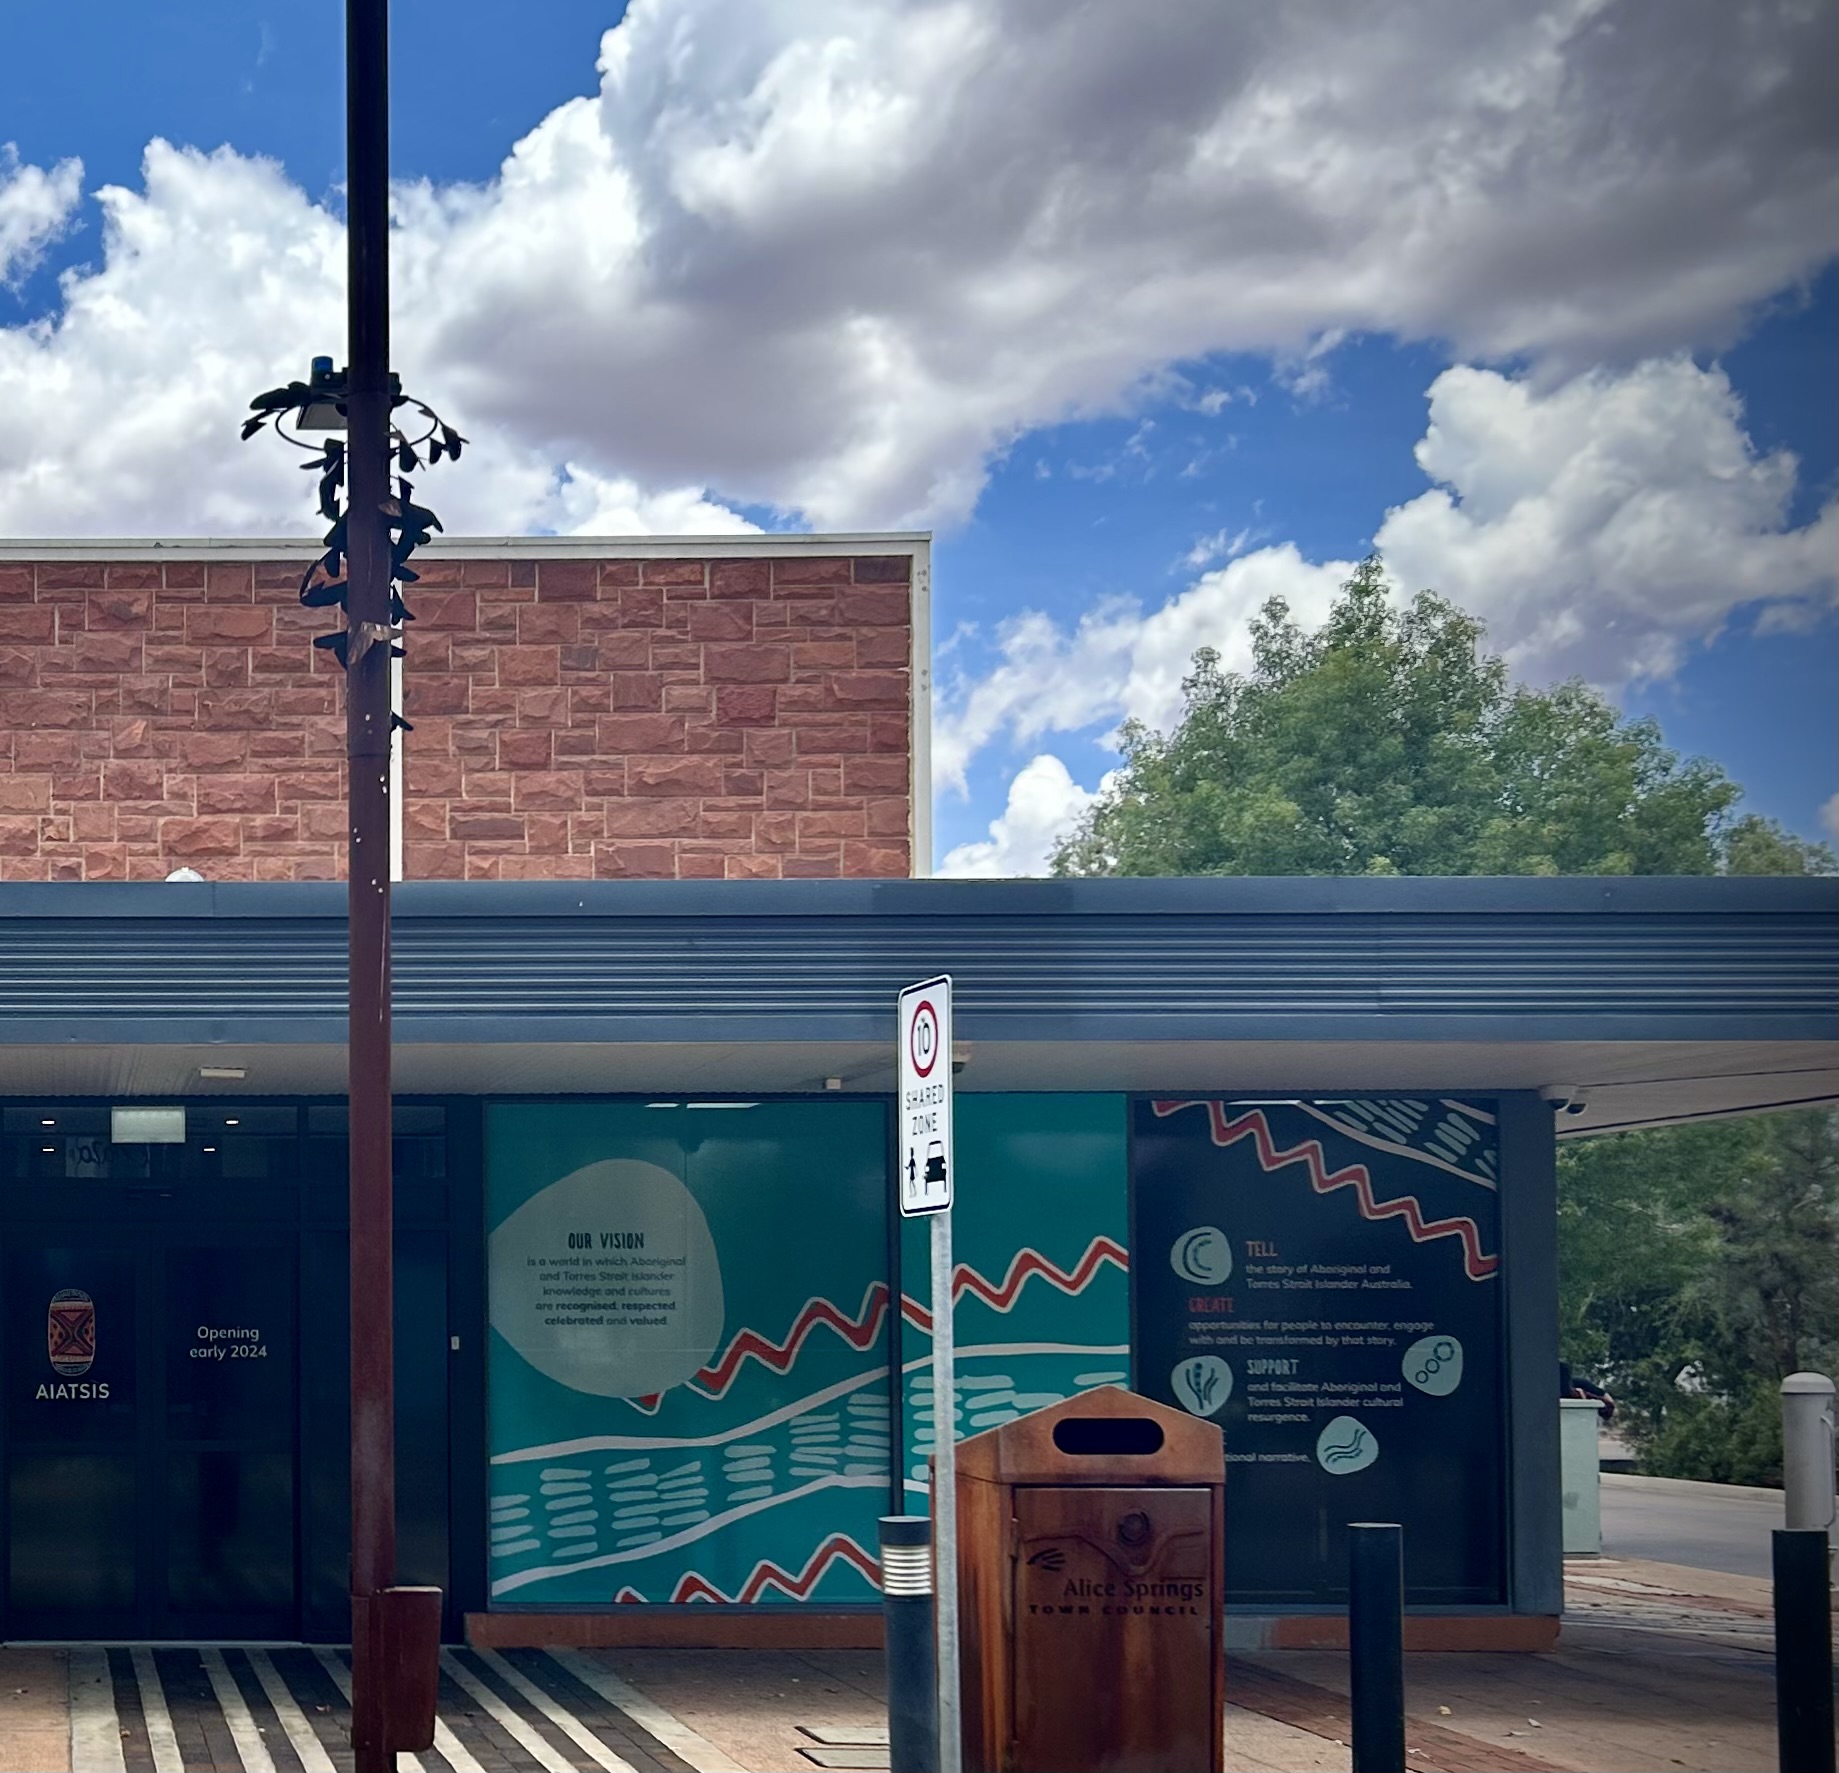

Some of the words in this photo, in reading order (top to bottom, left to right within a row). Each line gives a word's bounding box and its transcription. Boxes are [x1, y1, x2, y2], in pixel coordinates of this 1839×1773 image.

[918, 1023, 930, 1056] 10
[906, 1085, 944, 1110] SHARED
[912, 1113, 937, 1135] ZONE
[568, 1233, 592, 1249] OUR
[600, 1233, 644, 1249] VISION
[1245, 1241, 1278, 1257] TELL
[527, 1257, 535, 1266] is
[549, 1257, 579, 1266] world
[582, 1257, 592, 1266] in
[596, 1257, 627, 1266] which
[630, 1257, 686, 1268] Aboriginal
[1246, 1264, 1264, 1274] the
[1266, 1265, 1293, 1276] story
[1296, 1264, 1309, 1274] of
[1310, 1264, 1367, 1276] Aboriginal
[1368, 1264, 1391, 1274] and
[540, 1272, 559, 1281] and
[563, 1272, 596, 1281] Torres
[599, 1272, 629, 1281] Strait
[632, 1272, 673, 1281] Islander
[1246, 1279, 1280, 1289] Torres
[1282, 1279, 1313, 1289] Strait
[1315, 1279, 1359, 1289] Islander
[1361, 1279, 1413, 1289] Australia.
[543, 1287, 602, 1297] knowledge
[604, 1287, 625, 1296] and
[628, 1287, 670, 1296] cultures
[1188, 1297, 1233, 1313] CREATE
[545, 1316, 603, 1325] celebrated
[606, 1316, 627, 1325] and
[1188, 1321, 1261, 1332] opportunities
[1263, 1321, 1279, 1330] for
[1281, 1321, 1319, 1332] people
[1321, 1321, 1332, 1330] to
[1393, 1323, 1434, 1333] engage
[197, 1326, 259, 1342] Opening
[1189, 1336, 1214, 1345] with
[1216, 1336, 1238, 1345] and
[1240, 1336, 1254, 1345] be
[1256, 1336, 1324, 1345] transformed
[1326, 1336, 1339, 1347] by
[1341, 1336, 1365, 1345] that
[1367, 1336, 1397, 1347] story.
[189, 1345, 225, 1360] early
[231, 1345, 267, 1358] 2024
[1246, 1359, 1299, 1375] SUPPORT
[35, 1383, 110, 1400] AIATSIS
[1247, 1382, 1269, 1392] and
[1271, 1382, 1319, 1392] facilitate
[1321, 1382, 1378, 1394] Aboriginal
[1380, 1382, 1401, 1392] and
[1248, 1397, 1282, 1407] Torres
[1284, 1397, 1315, 1407] Strait
[1316, 1397, 1360, 1407] Islander
[1362, 1397, 1404, 1407] cultural
[1248, 1413, 1311, 1424] resurgence.
[1258, 1453, 1312, 1463] narrative.
[1063, 1578, 1115, 1598] Alice
[1123, 1579, 1203, 1601] Springs
[1029, 1604, 1089, 1615] TOWN
[1102, 1604, 1199, 1615] COUNCIL
